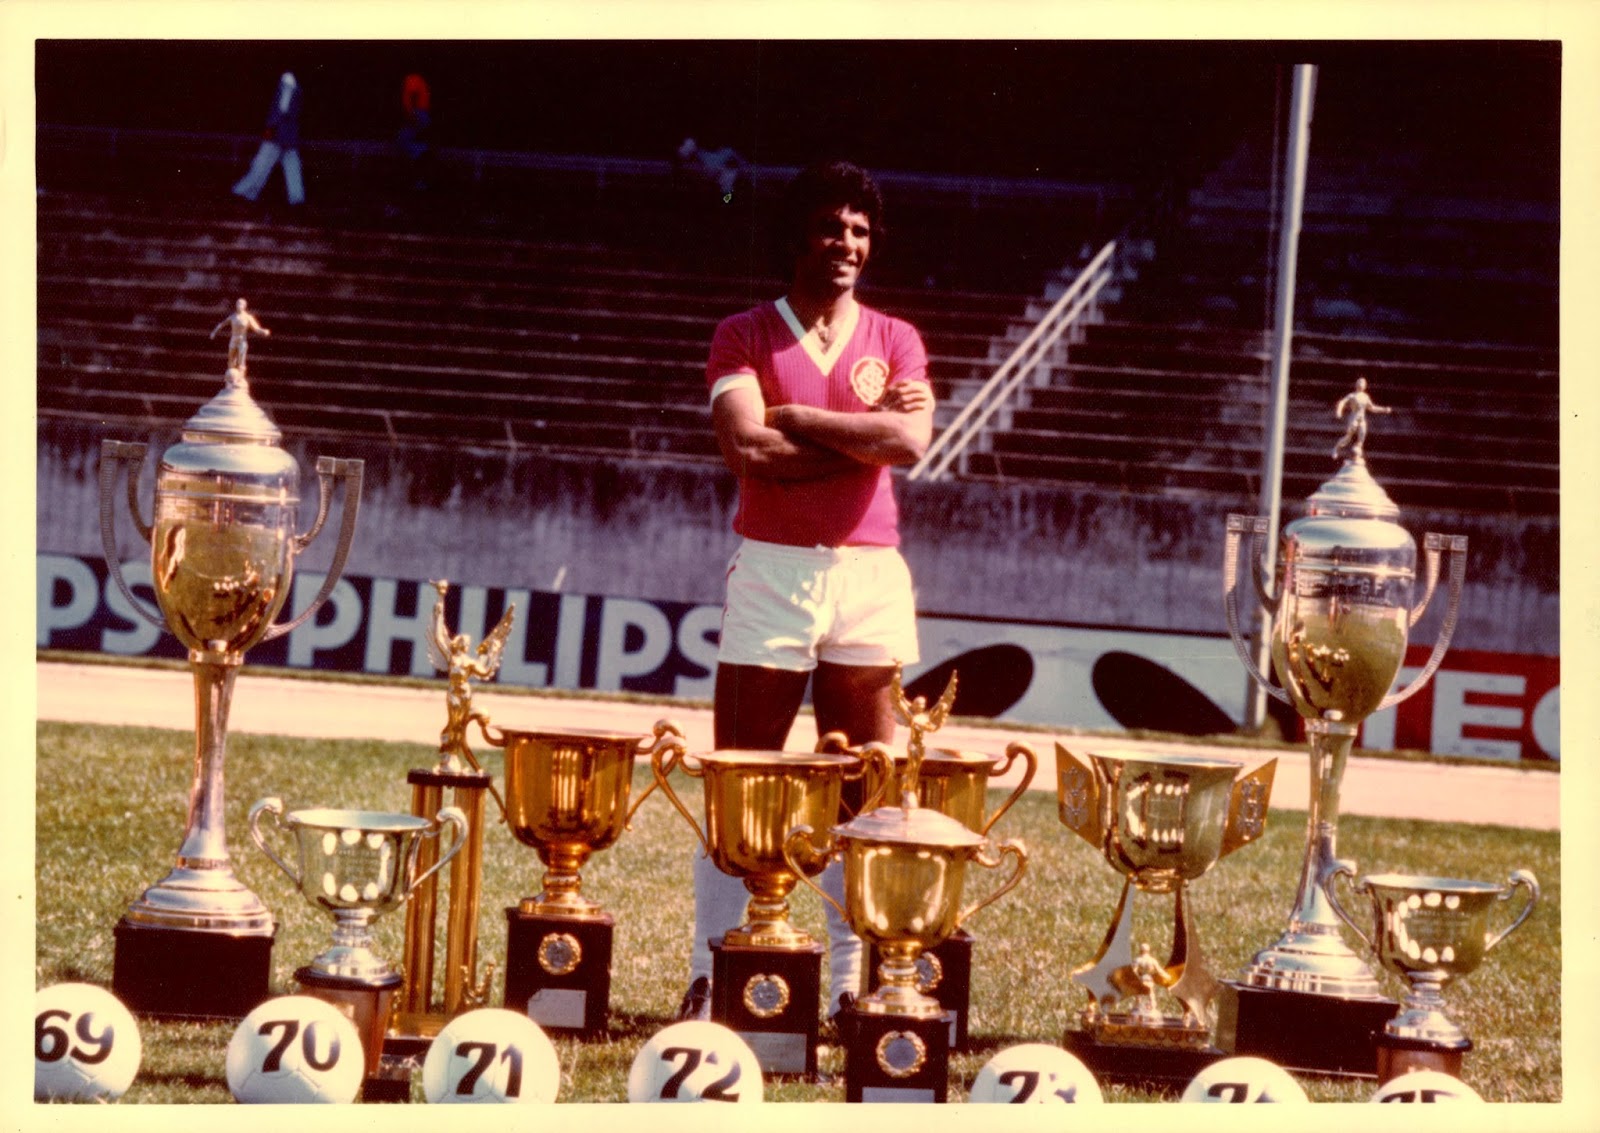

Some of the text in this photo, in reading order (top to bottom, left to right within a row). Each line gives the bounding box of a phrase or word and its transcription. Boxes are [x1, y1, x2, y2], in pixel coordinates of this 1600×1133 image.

[287, 572, 727, 697] PHILIPS
[1362, 667, 1560, 761] TE
[35, 1009, 115, 1065] 69
[258, 1020, 341, 1073] 70
[455, 1041, 523, 1098] 71
[659, 1046, 742, 1103] 72
